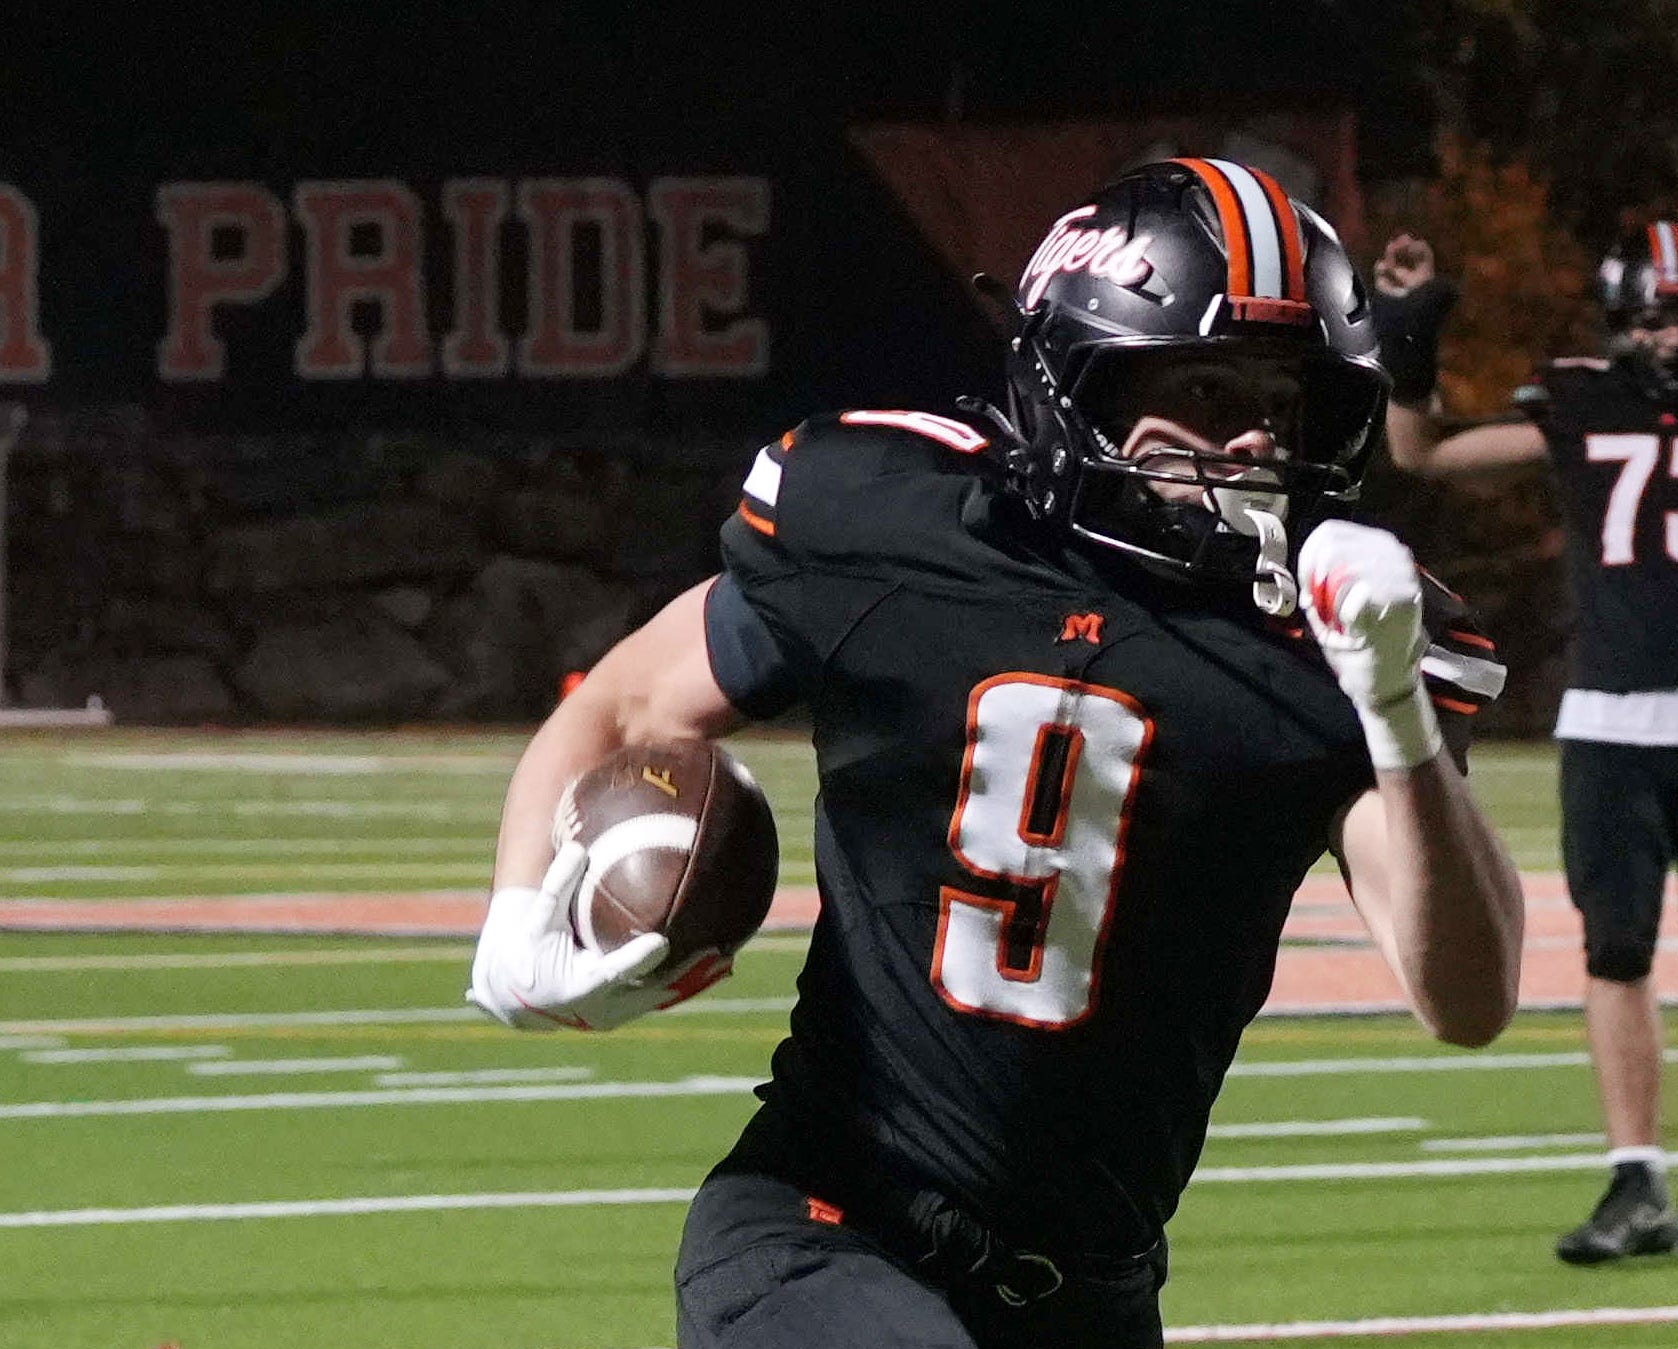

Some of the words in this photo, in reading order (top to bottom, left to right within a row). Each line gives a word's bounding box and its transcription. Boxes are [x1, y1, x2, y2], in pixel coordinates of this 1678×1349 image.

[155, 177, 772, 381] PRIDE
[1061, 612, 1105, 645] M
[930, 670, 1157, 1030] 9
